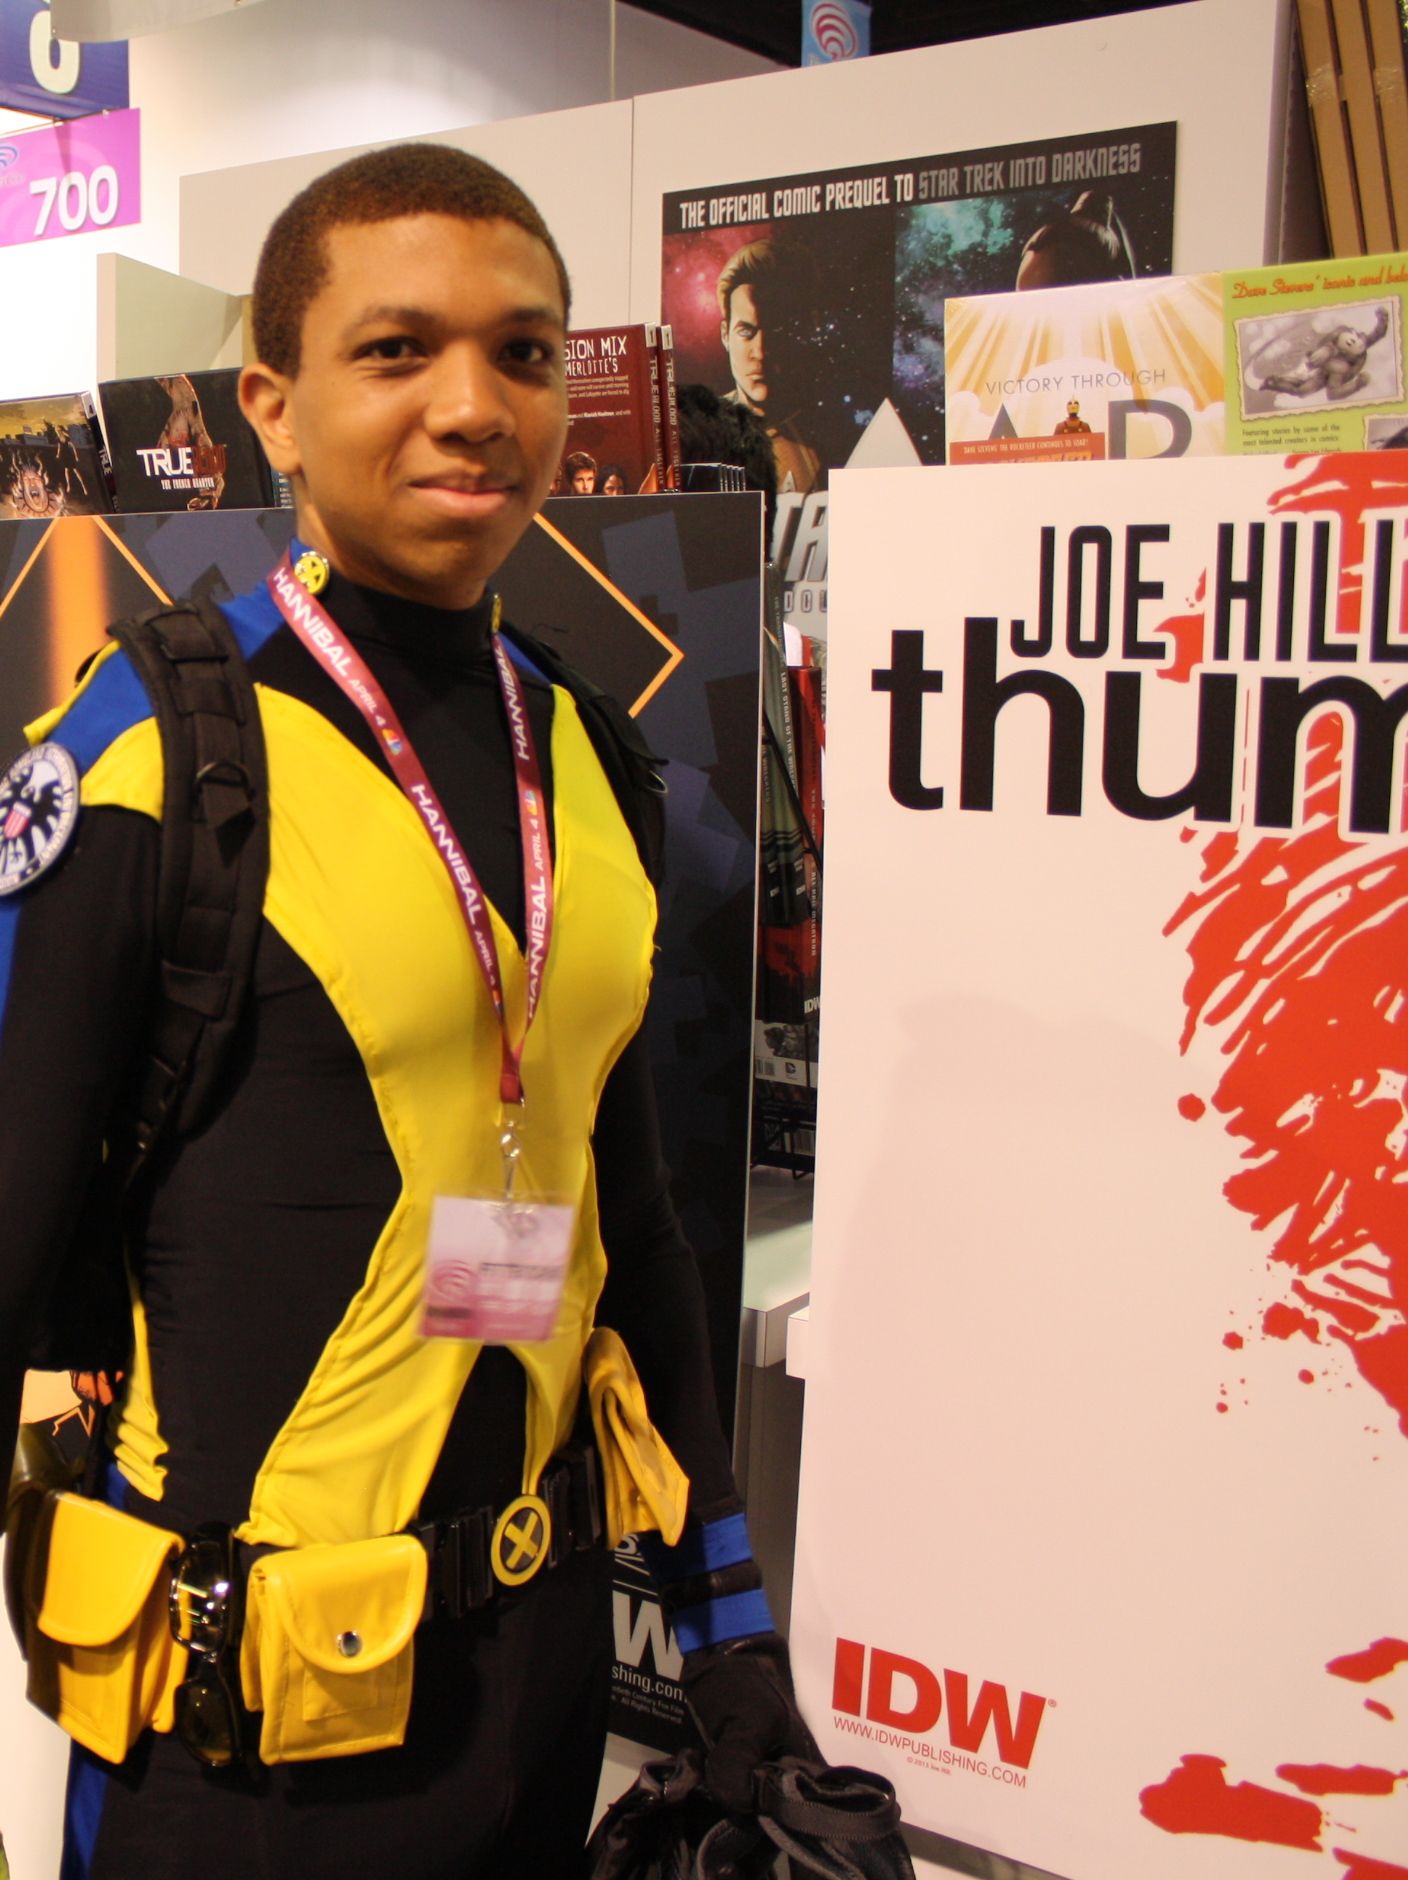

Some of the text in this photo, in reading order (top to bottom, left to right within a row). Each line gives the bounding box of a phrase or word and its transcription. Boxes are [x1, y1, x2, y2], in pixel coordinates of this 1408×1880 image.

[29, 165, 119, 236] 700
[680, 143, 1141, 229] THE OFFICIAL COMIC PREQUEL TO STAR TREK INTO DARKNESS
[1359, 266, 1384, 286] and
[565, 357, 619, 376] MERLOTTE'S
[601, 335, 627, 356] MIX
[986, 368, 1166, 396] VICTORY THROUGH
[136, 447, 194, 477] TRUE
[1010, 524, 1170, 660] JOE
[274, 567, 387, 727] HANNIBAL APRIL 4
[411, 783, 483, 925] HANNIBAL
[474, 930, 494, 972] APRIL
[527, 818, 547, 1019] HANNIBAL APRIL 4
[831, 1636, 1047, 1770] IDW
[833, 1716, 1027, 1789] WWW.IDWPUBLISHING.COM
